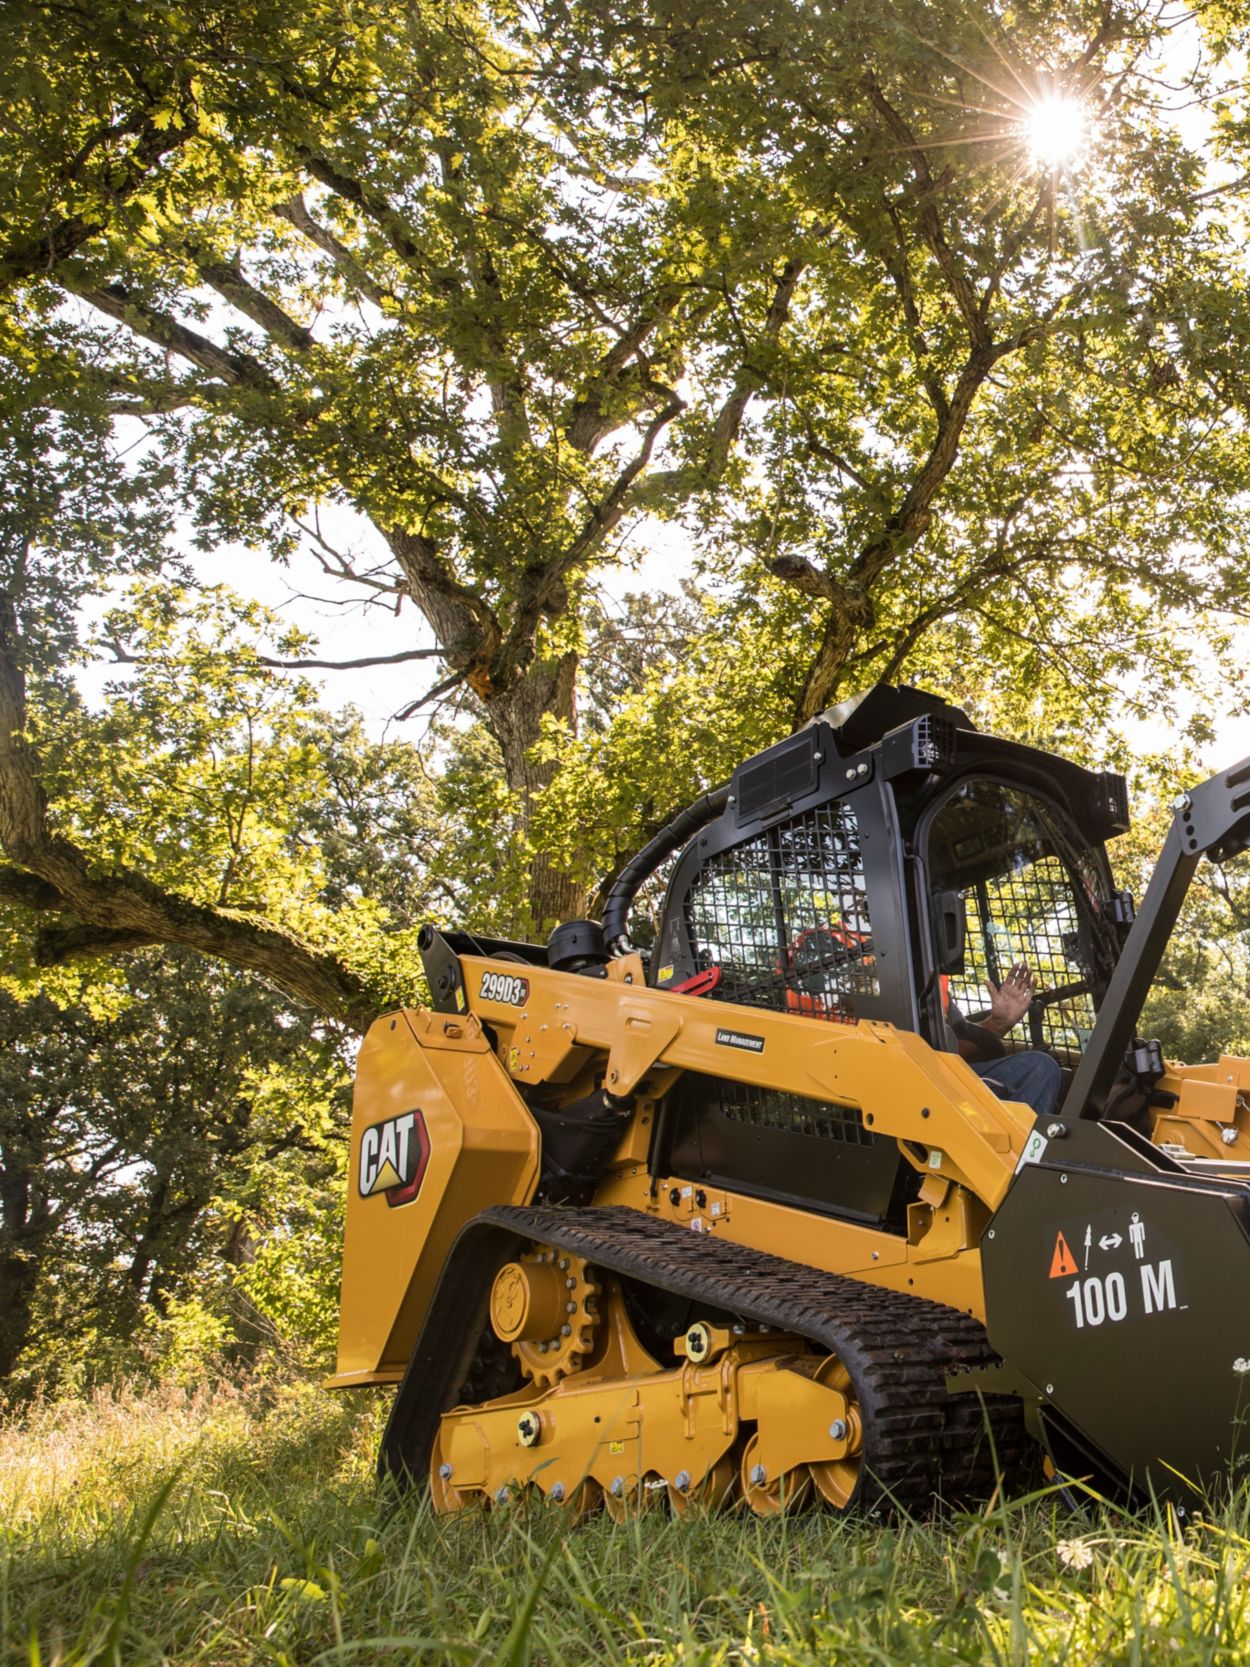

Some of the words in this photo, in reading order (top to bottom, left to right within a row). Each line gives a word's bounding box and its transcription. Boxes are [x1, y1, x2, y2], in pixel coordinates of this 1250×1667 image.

[480, 973, 521, 1004] 299D3
[359, 1113, 414, 1195] CAT
[1066, 1272, 1127, 1328] 100
